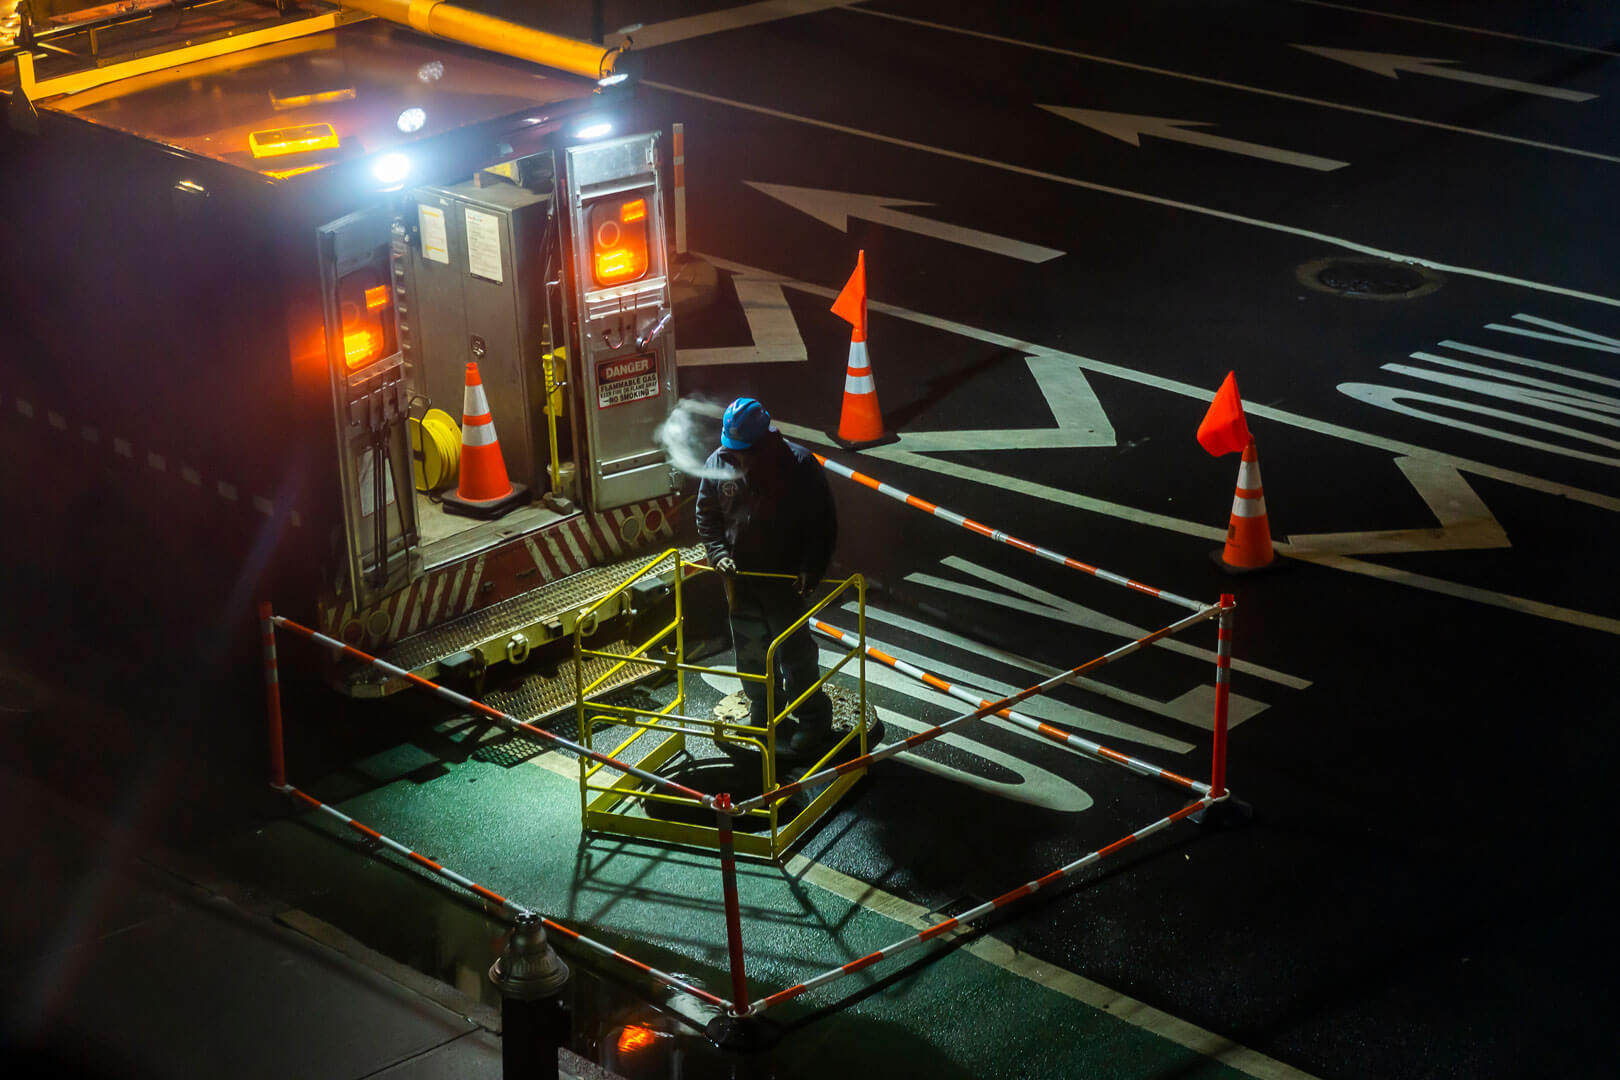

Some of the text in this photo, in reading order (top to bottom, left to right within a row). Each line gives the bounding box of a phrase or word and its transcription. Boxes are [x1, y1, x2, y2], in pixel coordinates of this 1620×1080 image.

[605, 359, 649, 379] DANGER
[600, 374, 657, 393] FLAMMABLE GAS
